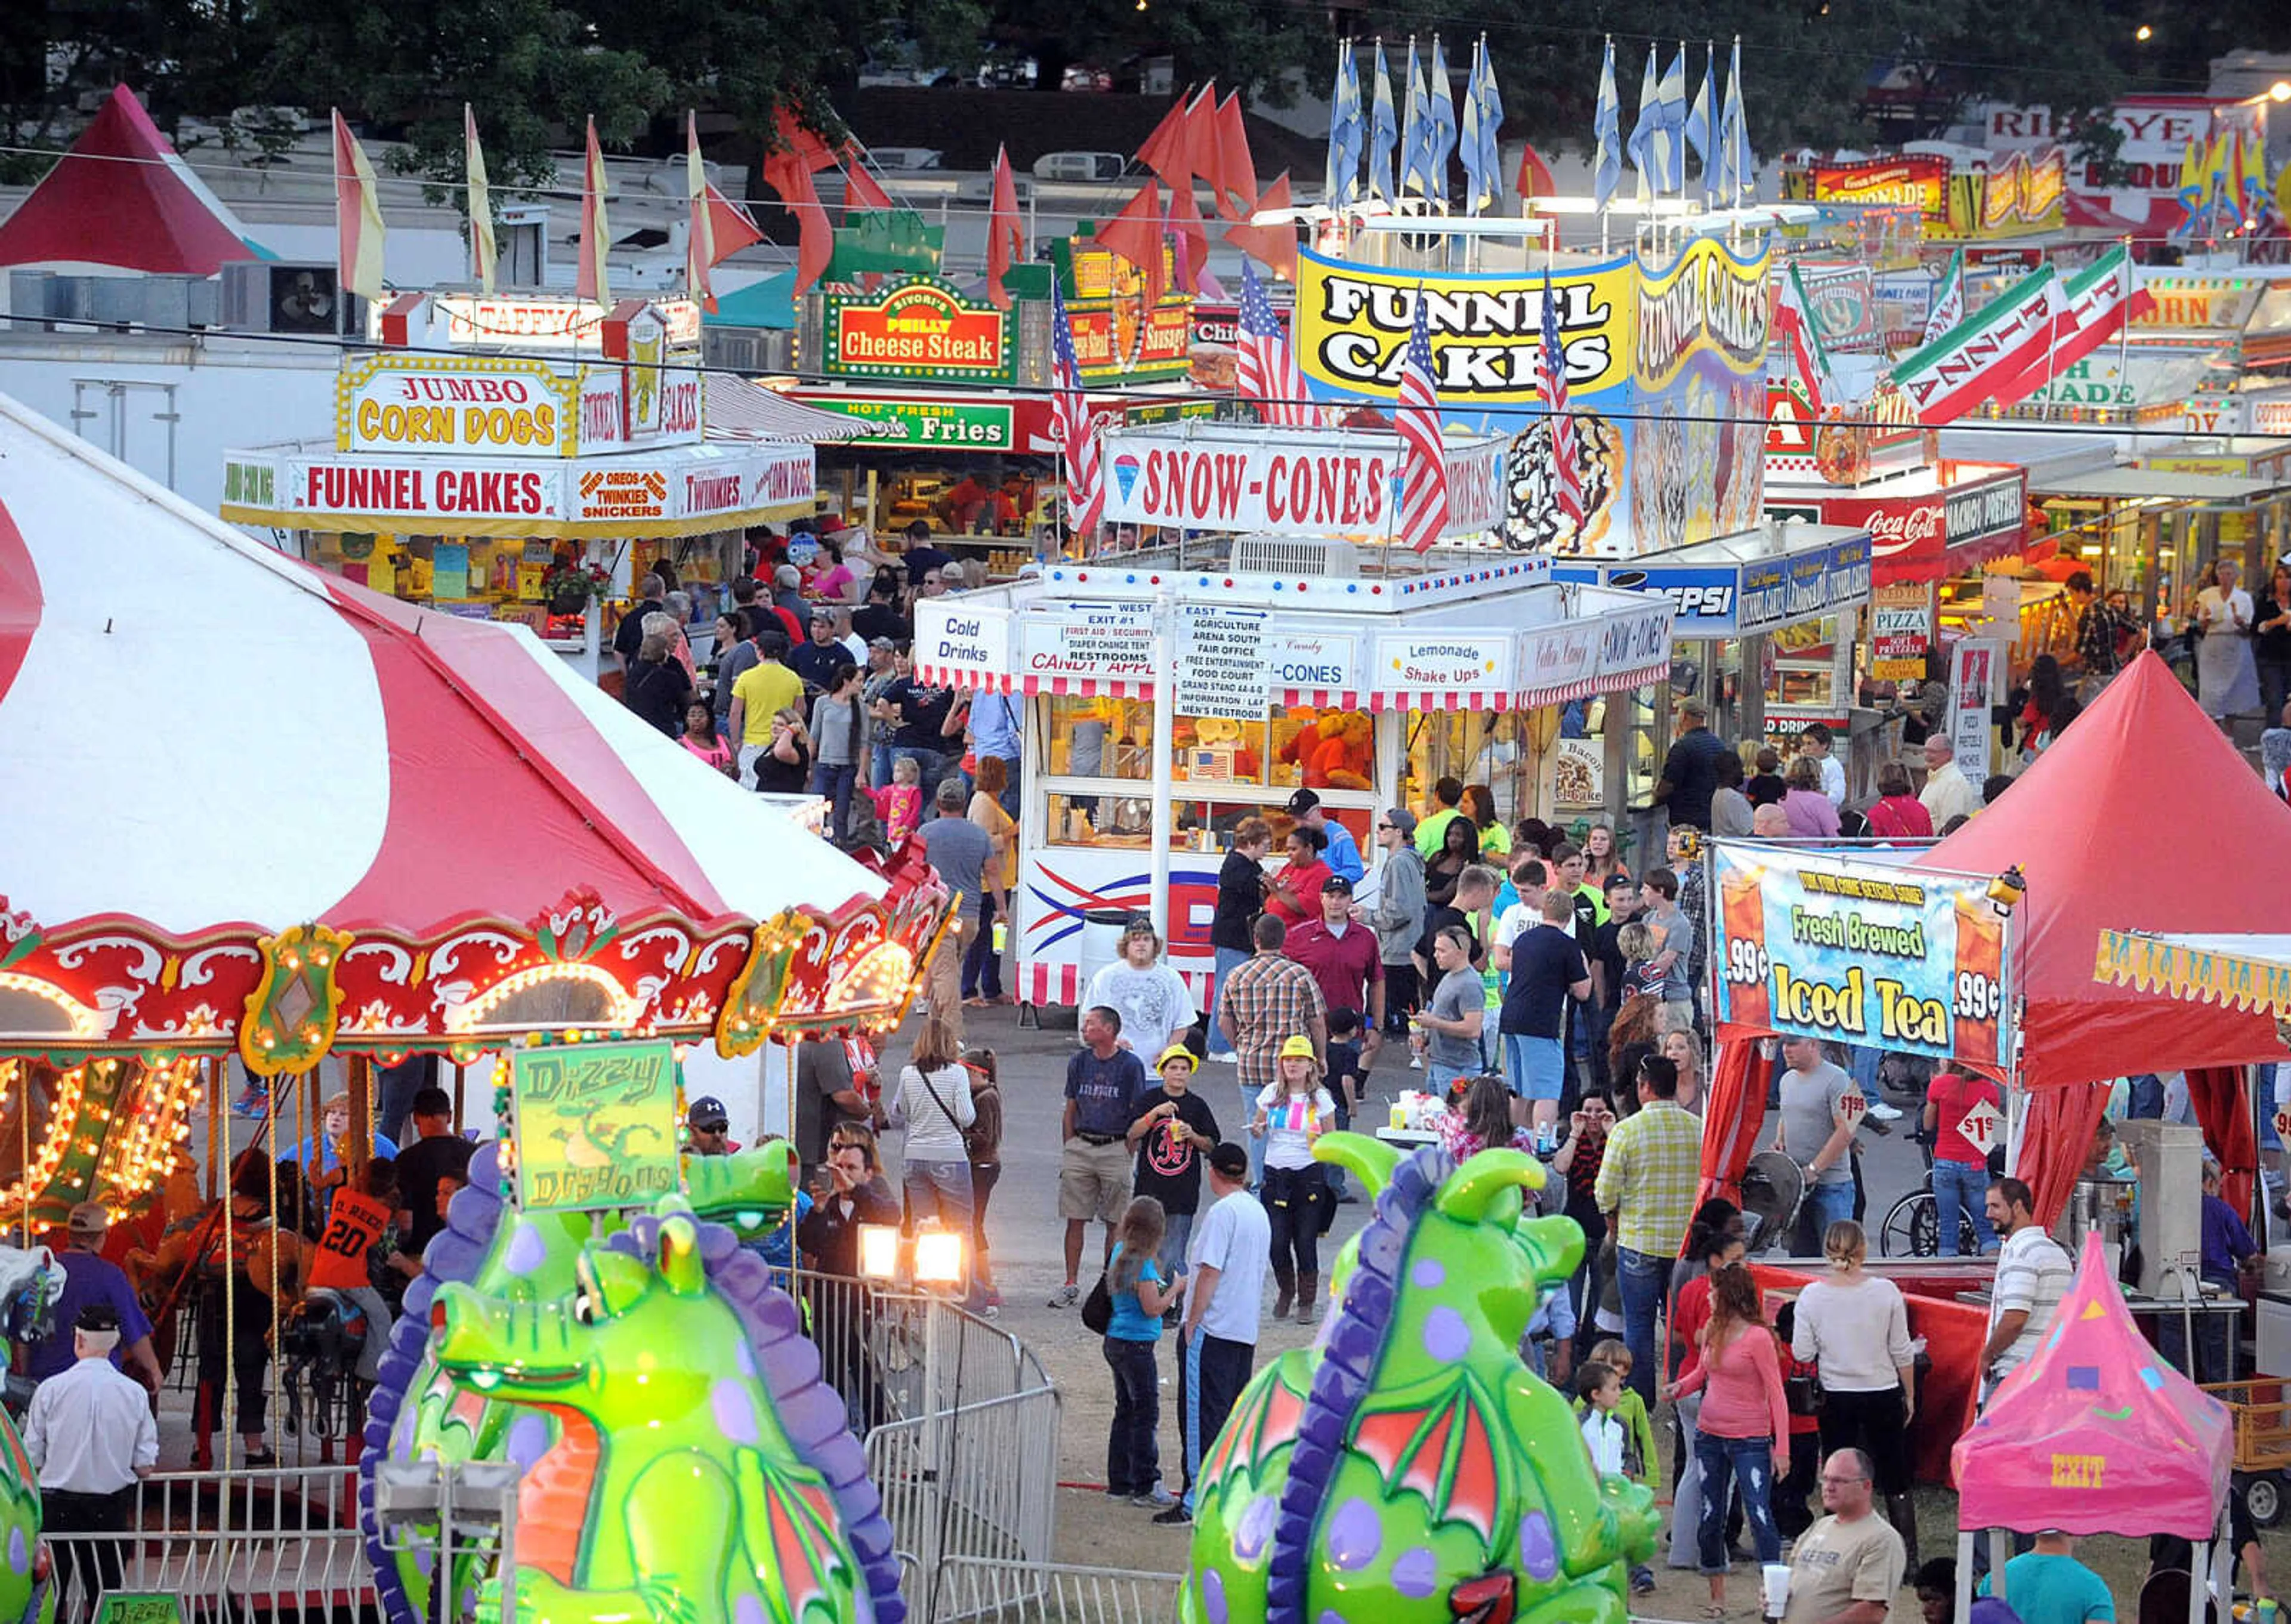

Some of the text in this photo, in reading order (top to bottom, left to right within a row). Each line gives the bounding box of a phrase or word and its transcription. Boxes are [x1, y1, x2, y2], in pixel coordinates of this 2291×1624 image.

[1323, 276, 1611, 336] FUNNEL
[480, 307, 566, 336] TAFFY
[1637, 251, 1767, 381] FUNNEL CAKES
[886, 318, 952, 334] PHILLY
[845, 331, 994, 360] Cheese Steak
[1146, 324, 1185, 357] Sausage
[1319, 332, 1611, 392] CAKES
[401, 376, 529, 404] JUMBO
[847, 403, 882, 415] HOT
[897, 405, 954, 417] FRESH
[357, 397, 556, 446] CORN DOGS
[920, 417, 1002, 442] Fries
[606, 471, 639, 485] OREOS
[308, 467, 427, 511] FUNNEL
[436, 470, 541, 514] CAKES
[686, 476, 740, 514] TWINKIES
[1144, 449, 1384, 525] SNOW-CONES
[597, 489, 648, 505] TWINKIES
[582, 505, 662, 518] SNICKERS
[1119, 604, 1151, 612] WEST
[1185, 607, 1216, 616] EAST
[946, 618, 980, 637] Cold
[1088, 616, 1116, 624] EXIT
[1193, 619, 1261, 631] AGRICULTURE
[1876, 613, 1926, 628] PIZZA
[1066, 627, 1088, 635] FIRST
[1193, 632, 1261, 644] ARENA SOUTH
[938, 641, 988, 663] Drinks
[1070, 652, 1147, 662] RESTROOMS
[1197, 644, 1255, 657] FAIR OFFICE
[1410, 644, 1479, 660] Lemonade
[1879, 644, 1922, 654] PRETZELS
[1107, 663, 1156, 675] APPL
[1185, 656, 1265, 669] FREE ENTERTAINMENT
[1192, 669, 1255, 681] FOOD COURT
[1270, 663, 1342, 684] -CONES
[1404, 666, 1480, 683] Shake Ups
[1182, 680, 1208, 690] GRAND
[1211, 682, 1236, 692] STAND
[1181, 694, 1240, 704] INFORMATION
[1182, 705, 1262, 718] MEN'S RESTROOM
[1792, 904, 1925, 959] Fresh Brewed
[1773, 964, 1949, 1046] Iced Tea
[524, 1054, 665, 1105] Dizzy
[530, 1163, 675, 1207] Dragons
[324, 1218, 368, 1258] 20
[2051, 1453, 2107, 1489] EXIT
